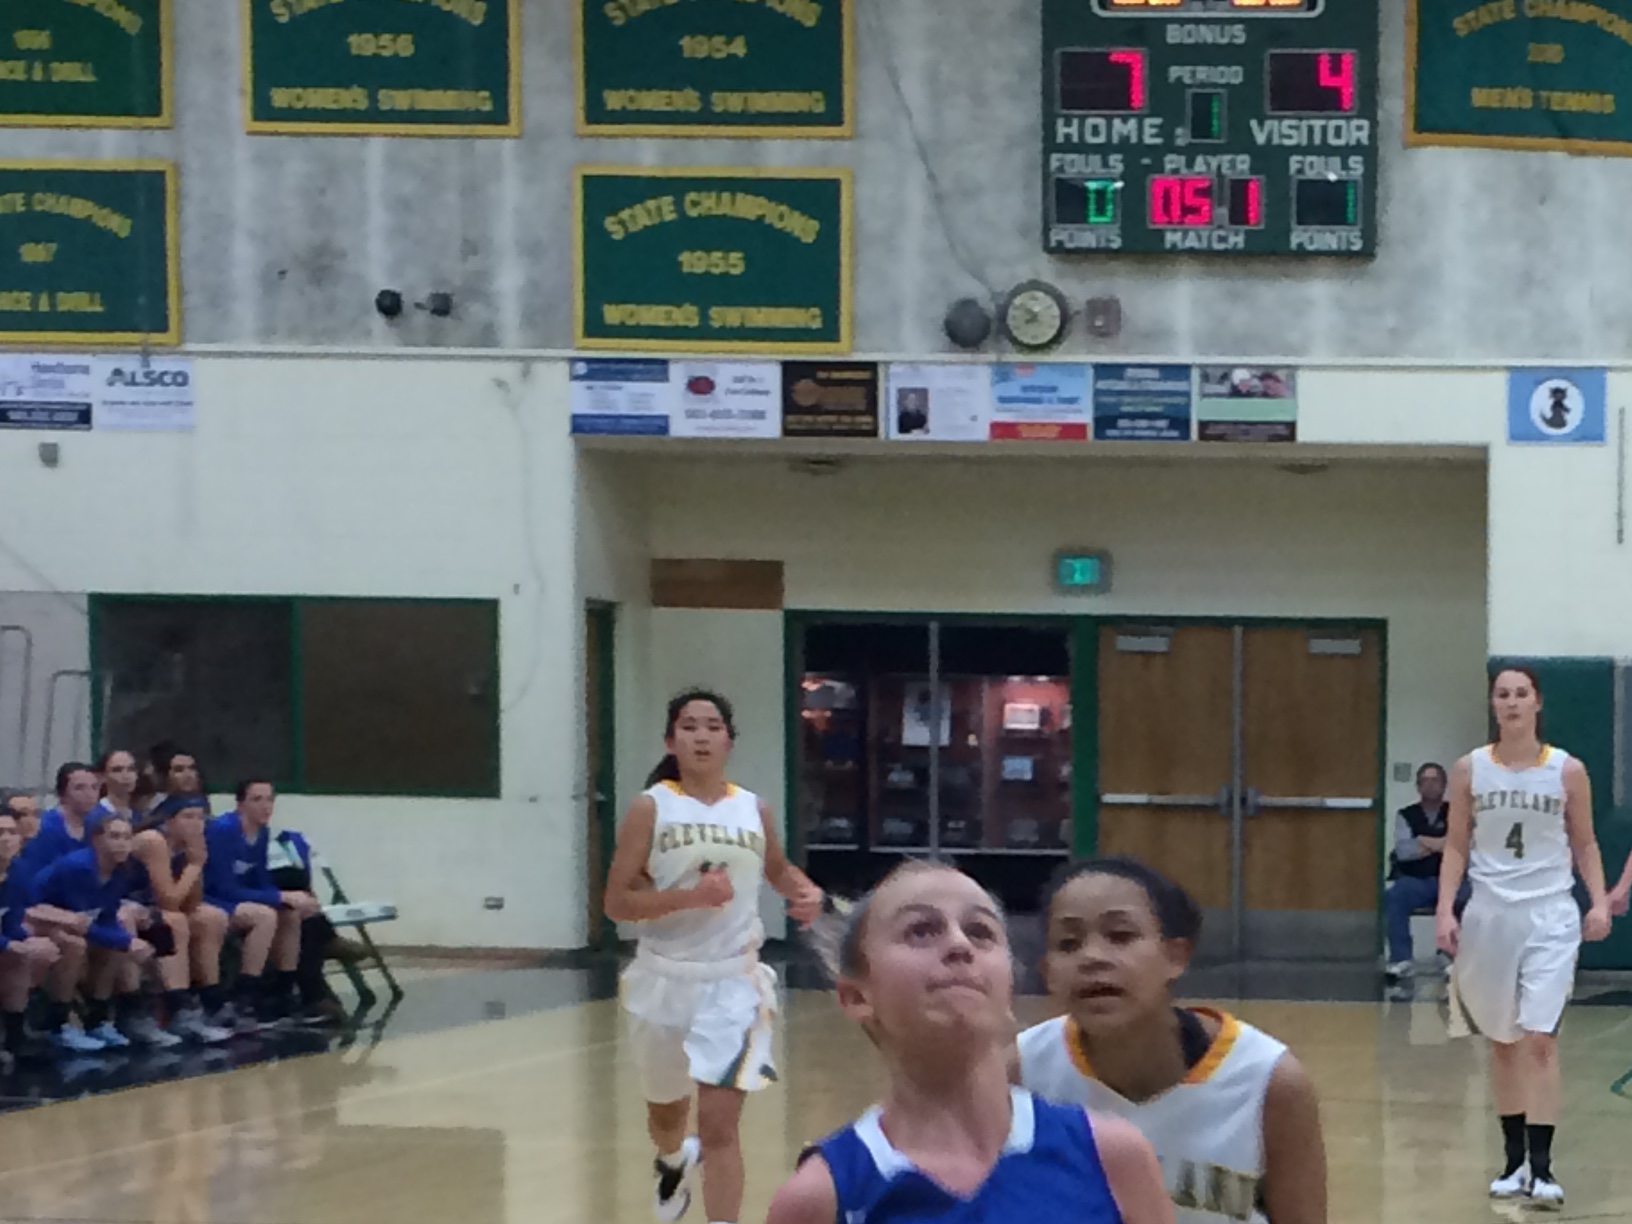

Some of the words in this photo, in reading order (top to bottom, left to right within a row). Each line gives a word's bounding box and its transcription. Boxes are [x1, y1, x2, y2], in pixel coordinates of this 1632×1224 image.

[347, 32, 415, 57] 1956
[679, 34, 747, 59] 1954
[1166, 24, 1246, 44] BONUS
[1109, 49, 1144, 109] 7
[1167, 66, 1243, 84] PERIOD
[1317, 51, 1353, 111] 4
[1055, 117, 1164, 144] HOME
[1250, 119, 1371, 146] VISITOR
[1051, 154, 1124, 173] FOULS
[1163, 154, 1251, 174] PLAYER
[1289, 155, 1365, 175] FOULS
[1085, 179, 1117, 223] 0
[604, 196, 678, 240] STATE
[684, 191, 820, 243] CHAMPIONS
[1051, 229, 1122, 249] POINTS
[1164, 230, 1245, 249] MATCH
[1290, 230, 1363, 250] POINTS
[678, 250, 746, 275] 1955
[106, 368, 190, 387] ALSCO
[1505, 822, 1525, 859] 4
